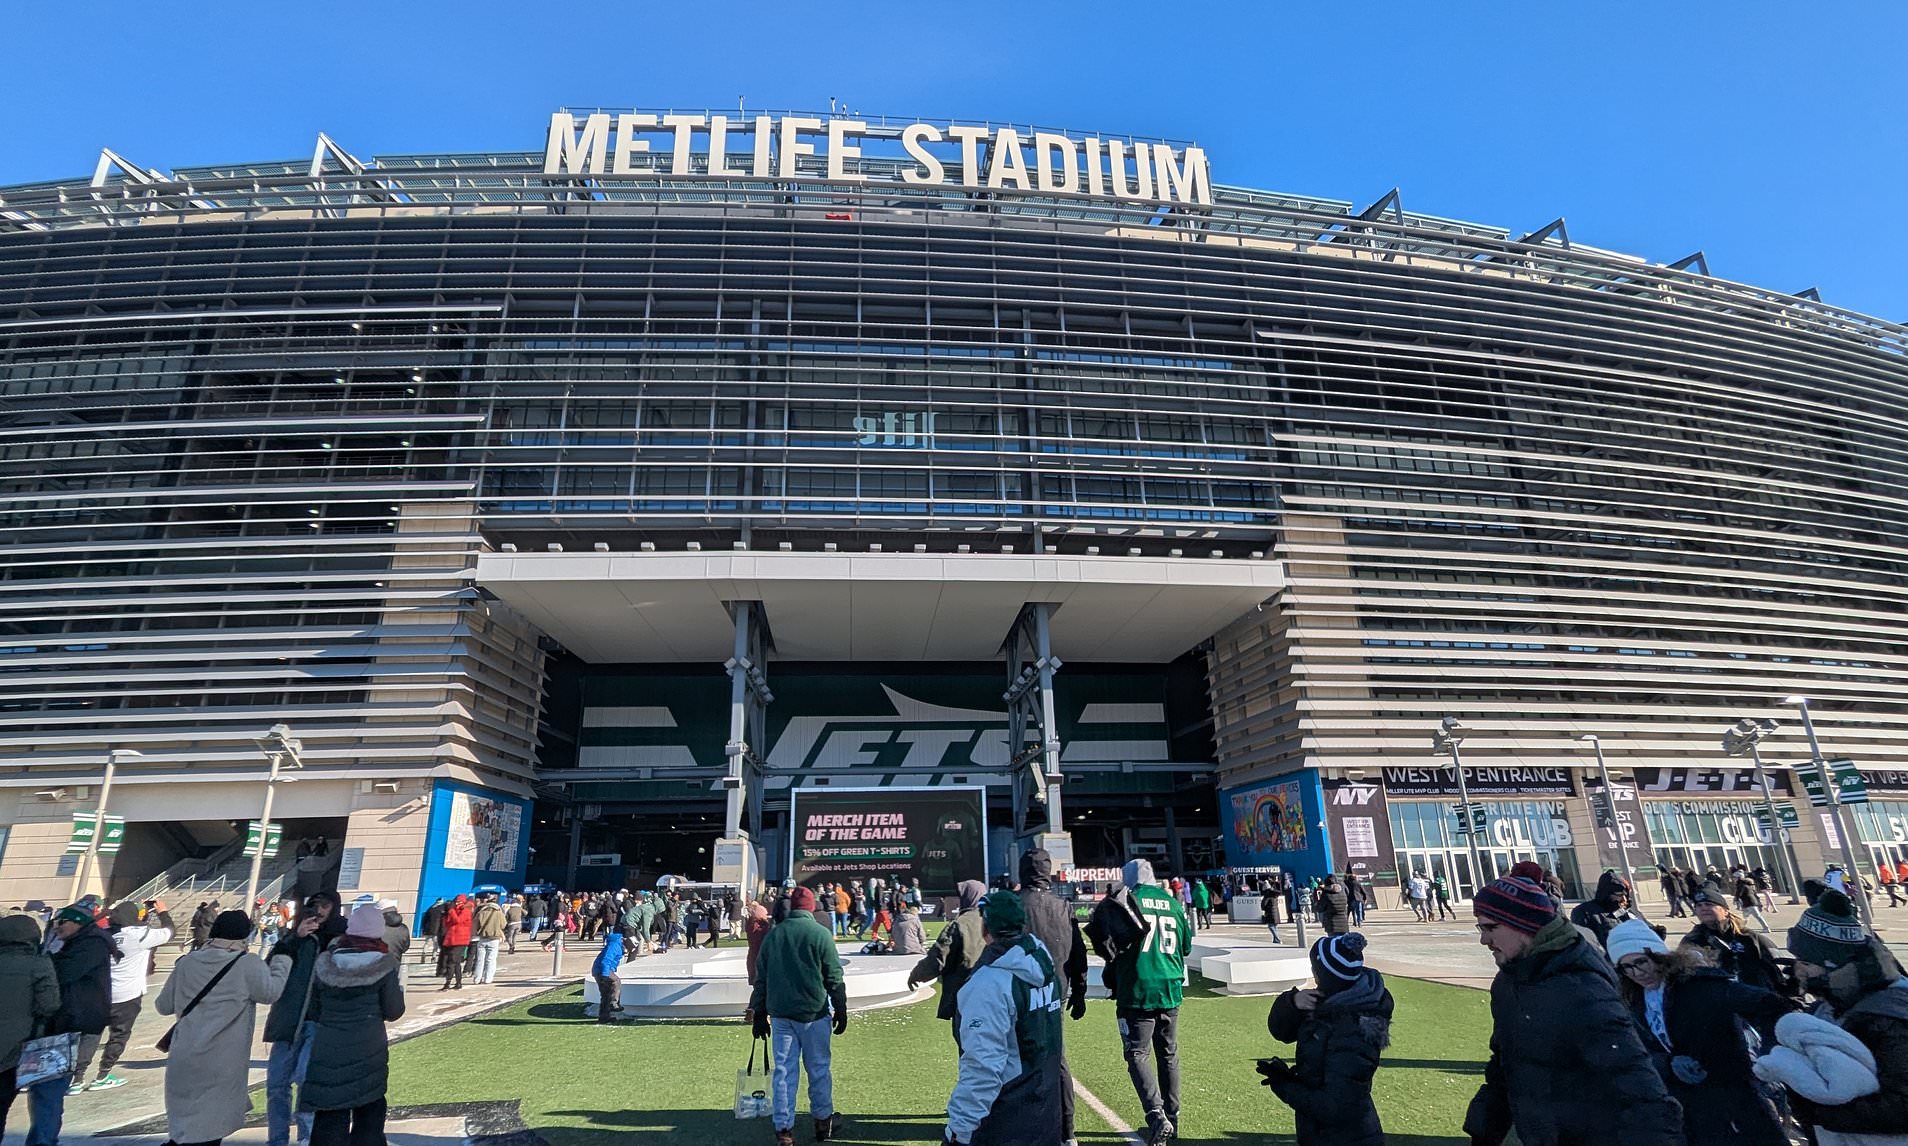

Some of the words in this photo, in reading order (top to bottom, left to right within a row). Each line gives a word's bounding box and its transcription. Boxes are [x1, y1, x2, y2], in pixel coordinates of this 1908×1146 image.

[544, 112, 868, 182] METLIFE
[901, 123, 1213, 205] STADIUM
[1385, 767, 1440, 783] WEST
[1445, 767, 1473, 783] VP
[1476, 767, 1568, 783] ENTRANCE
[1644, 768, 1777, 791] J-E-T-S
[1877, 771, 1896, 785] VIP
[1332, 785, 1378, 805] NY
[1589, 781, 1635, 801] TS
[1444, 801, 1497, 816] MER
[1500, 801, 1532, 815] LITE
[1535, 801, 1566, 815] MVP
[1682, 801, 1757, 814] COMMISSION
[807, 814, 864, 827] MERCH
[865, 813, 904, 826] ITEM
[1615, 811, 1632, 821] EST
[805, 828, 826, 841] OF
[829, 828, 859, 840] THE
[860, 827, 907, 840] GAME
[1493, 818, 1572, 847] CLUB
[803, 848, 821, 857] 15%
[822, 848, 839, 856] OFF
[840, 847, 870, 856] GREEN
[870, 846, 911, 855] T-SHIRTS
[927, 850, 947, 858] JETS
[801, 863, 833, 872] Available
[841, 863, 858, 871] Jets
[858, 863, 877, 872] Shop
[877, 862, 912, 870] Locations
[1142, 898, 1171, 912] HOLDER
[1141, 914, 1178, 955] 76
[1029, 981, 1055, 1012] NY
